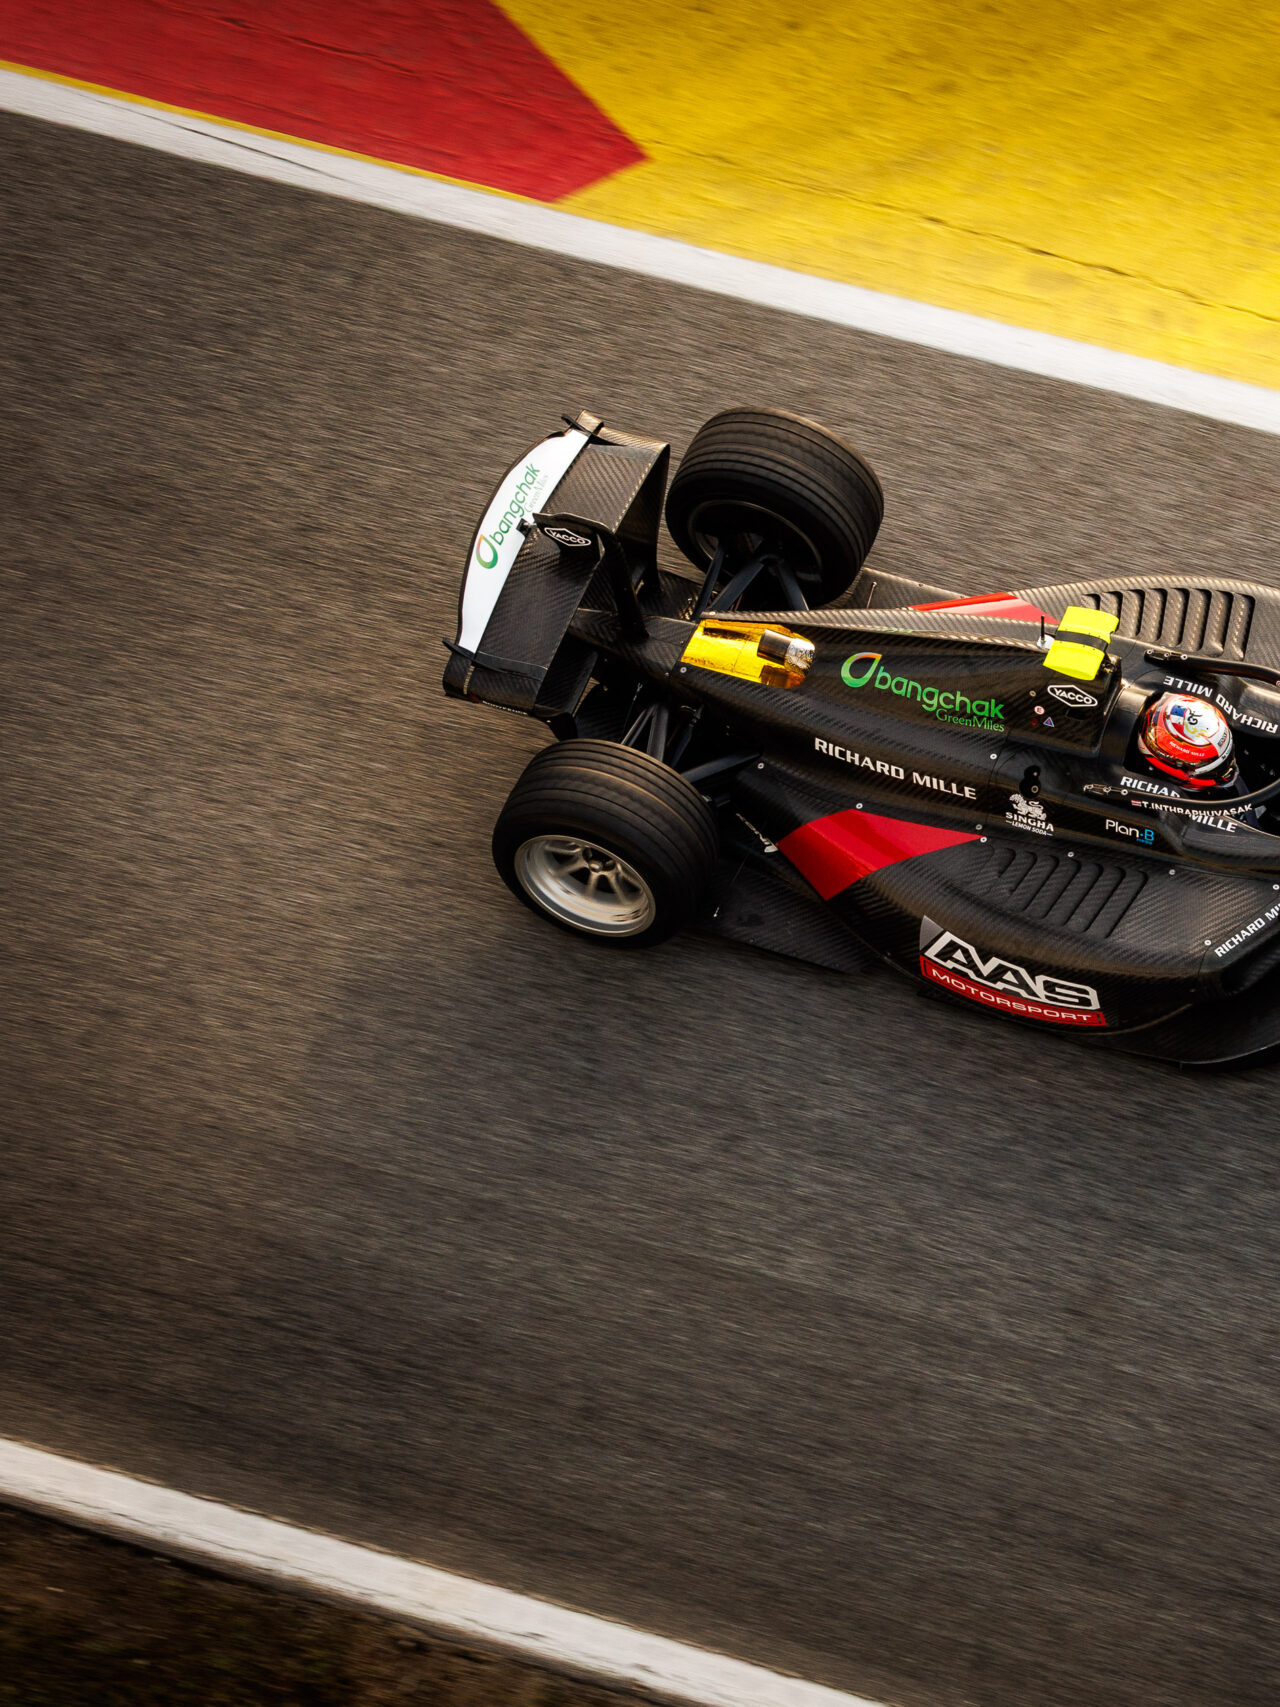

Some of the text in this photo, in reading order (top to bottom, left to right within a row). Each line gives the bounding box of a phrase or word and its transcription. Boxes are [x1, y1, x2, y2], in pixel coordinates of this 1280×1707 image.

[489, 463, 540, 546] bangchak
[550, 530, 586, 545] YACCO
[874, 666, 1005, 719] bangchak
[1053, 687, 1093, 705] YACCO
[1162, 675, 1214, 698] MILLE
[936, 708, 1005, 733] GreenMiles
[1215, 694, 1279, 734] RICHARD
[814, 737, 977, 800] RICHARD MILLE
[1005, 811, 1054, 832] SINGHA
[1011, 820, 1047, 836] LEMON SODA
[1214, 917, 1266, 958] RICHARD
[932, 968, 1091, 1021] MOTORSPORT
